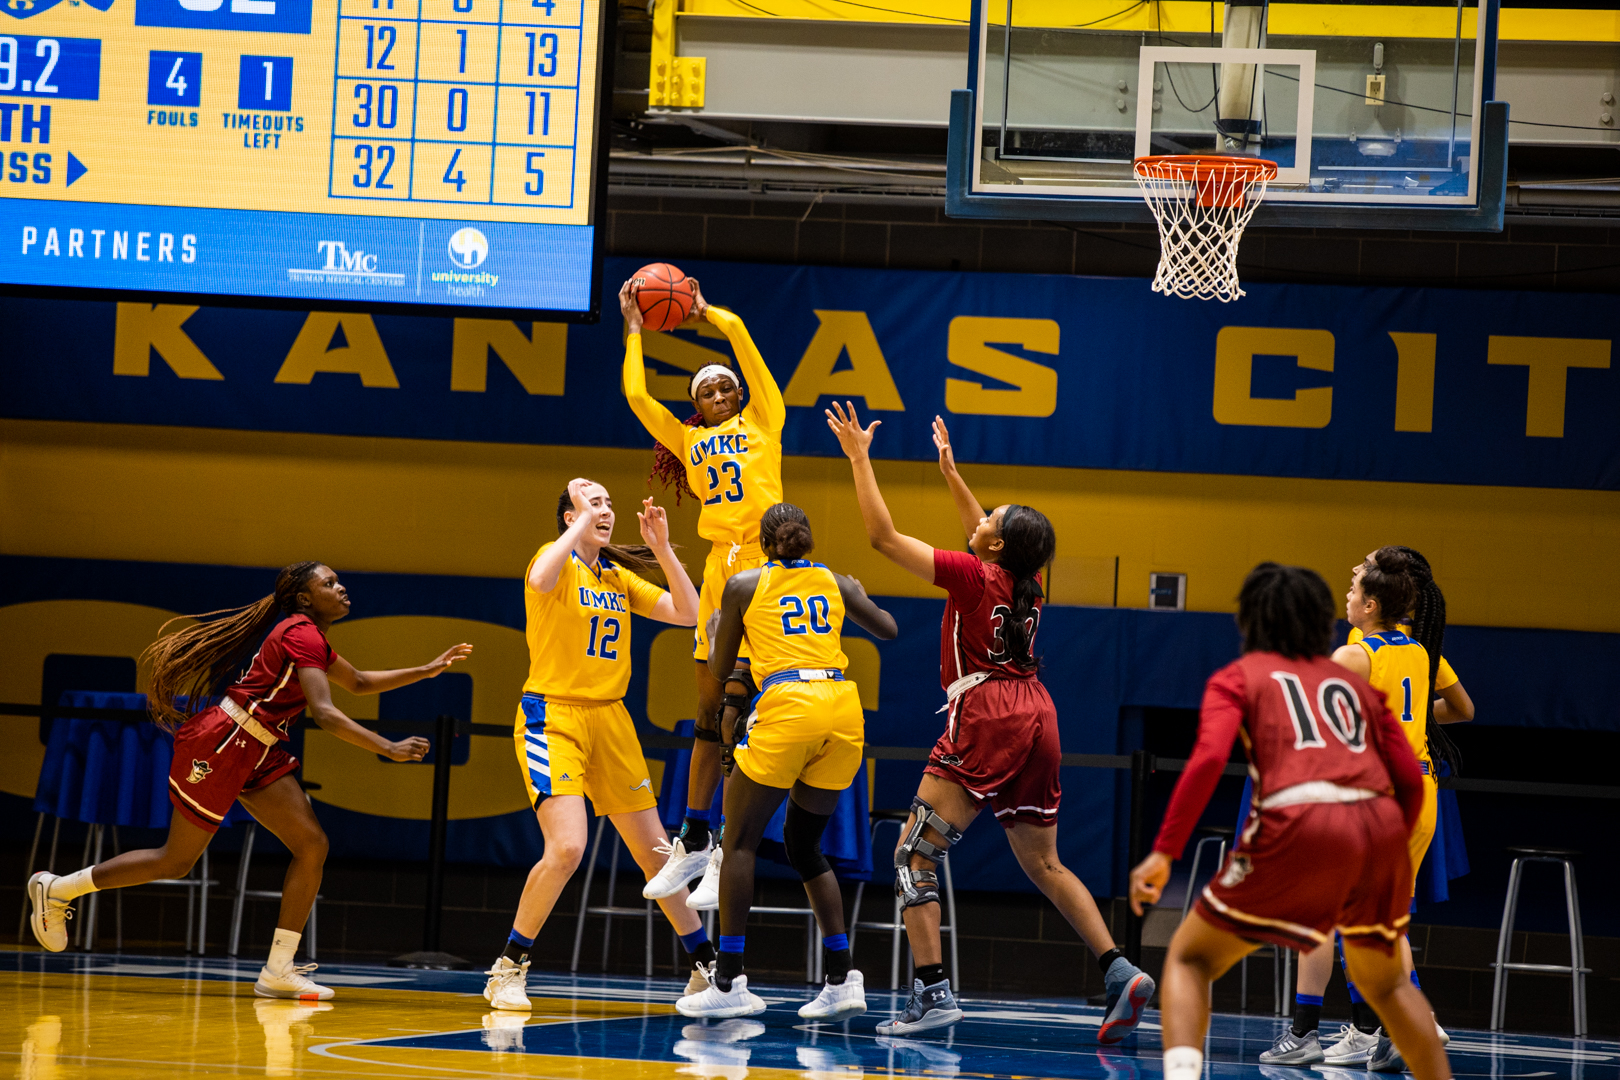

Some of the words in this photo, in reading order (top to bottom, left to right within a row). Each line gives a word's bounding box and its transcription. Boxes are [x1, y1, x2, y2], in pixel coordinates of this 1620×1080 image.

[0, 37, 60, 93] 9.2
[363, 25, 397, 70] 12
[456, 29, 467, 74] 1
[525, 32, 558, 77] 13
[166, 57, 187, 96] 4
[263, 61, 273, 101] 1
[0, 103, 51, 144] TH
[147, 110, 199, 127] FOULS
[222, 113, 304, 132] TIMEOUTS
[353, 84, 398, 129] 30
[447, 88, 468, 132] 0
[525, 91, 551, 136] 11
[243, 132, 281, 149] LEFT
[0, 151, 52, 184] SS
[353, 144, 395, 189] 32
[442, 148, 467, 193] 4
[524, 151, 545, 196] 5
[22, 226, 197, 263] PARTNERS
[431, 270, 498, 287] university
[447, 284, 485, 298] health
[113, 302, 1060, 417] KANSAS
[1213, 326, 1612, 438] CIT
[691, 433, 749, 467] UMKC
[703, 460, 744, 506] 23
[578, 586, 626, 613] UMKC
[779, 595, 833, 636] 20
[586, 615, 621, 661] 12
[1271, 671, 1367, 753] 10
[1401, 677, 1413, 722] 1
